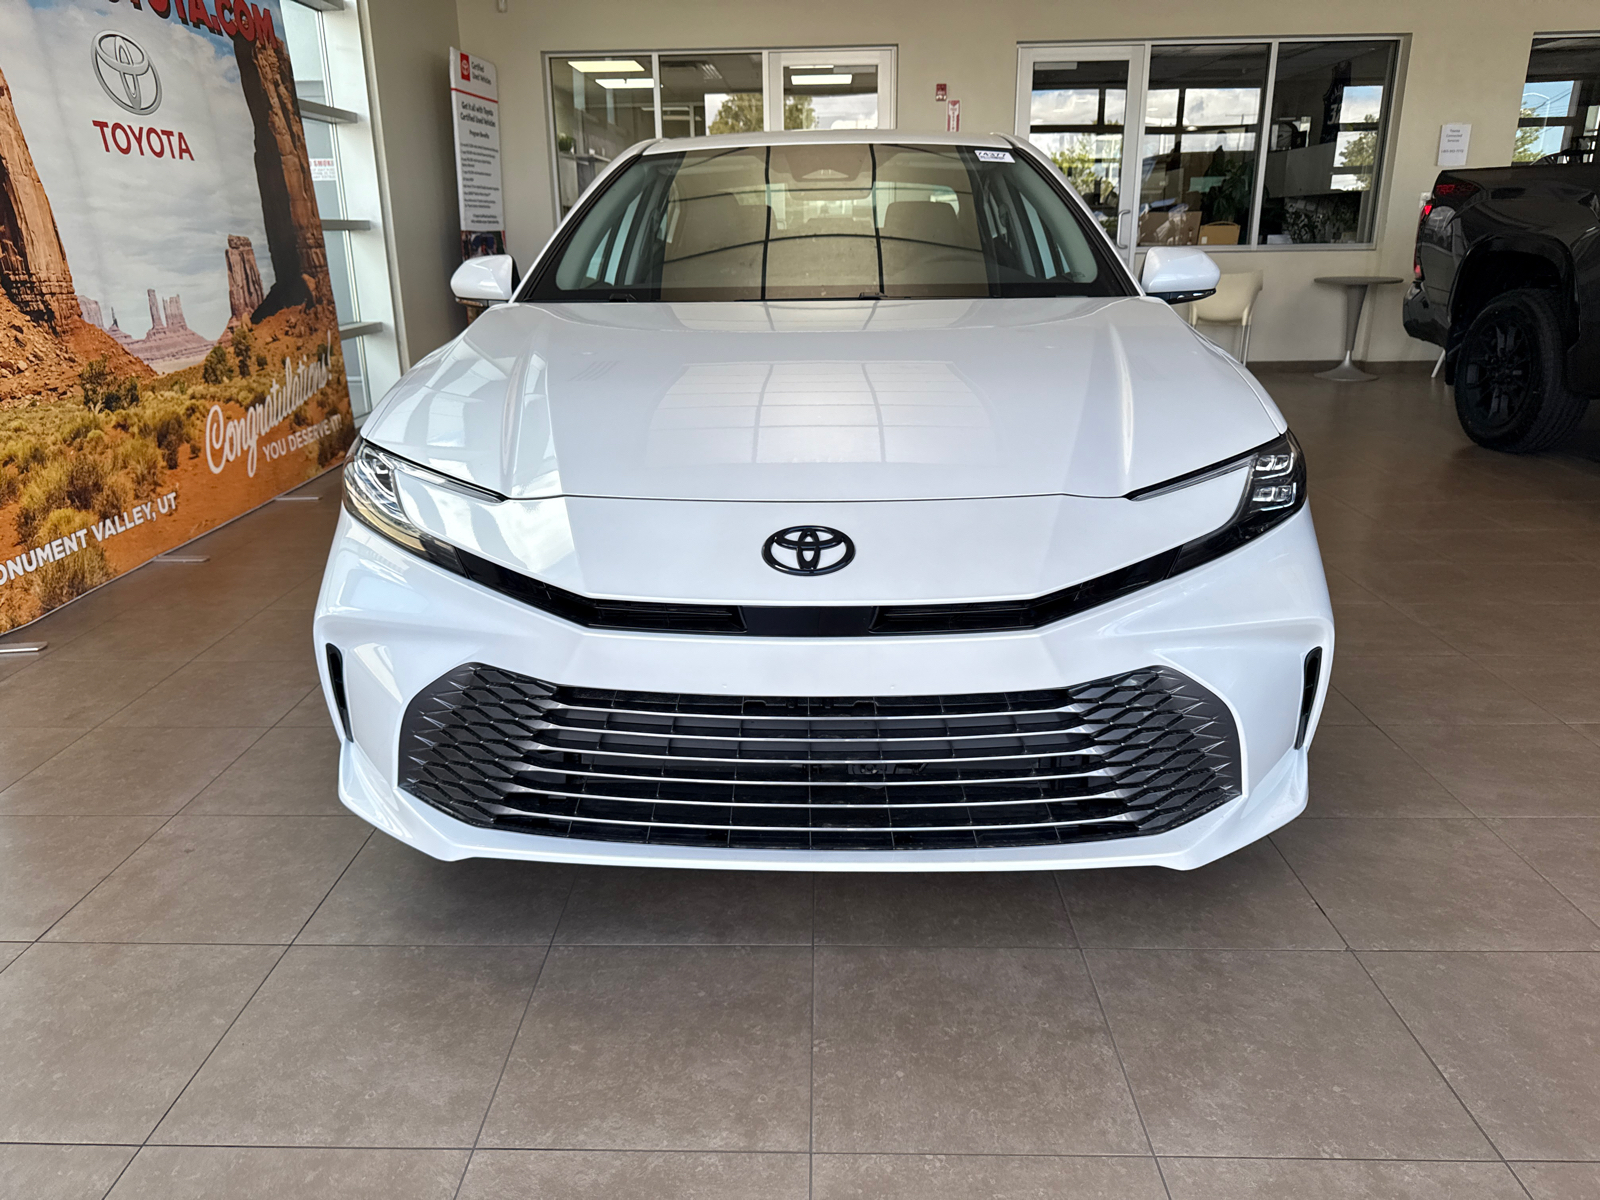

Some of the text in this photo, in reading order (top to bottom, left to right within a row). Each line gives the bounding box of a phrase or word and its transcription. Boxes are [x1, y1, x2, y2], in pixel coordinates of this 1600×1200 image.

[109, 0, 278, 49] TA.COM
[92, 120, 195, 161] TOYOTA
[206, 329, 332, 478] Congratulations!
[262, 413, 342, 462] YOU DESERVE IT!
[91, 501, 157, 542] VALLEY,
[157, 492, 177, 514] UT
